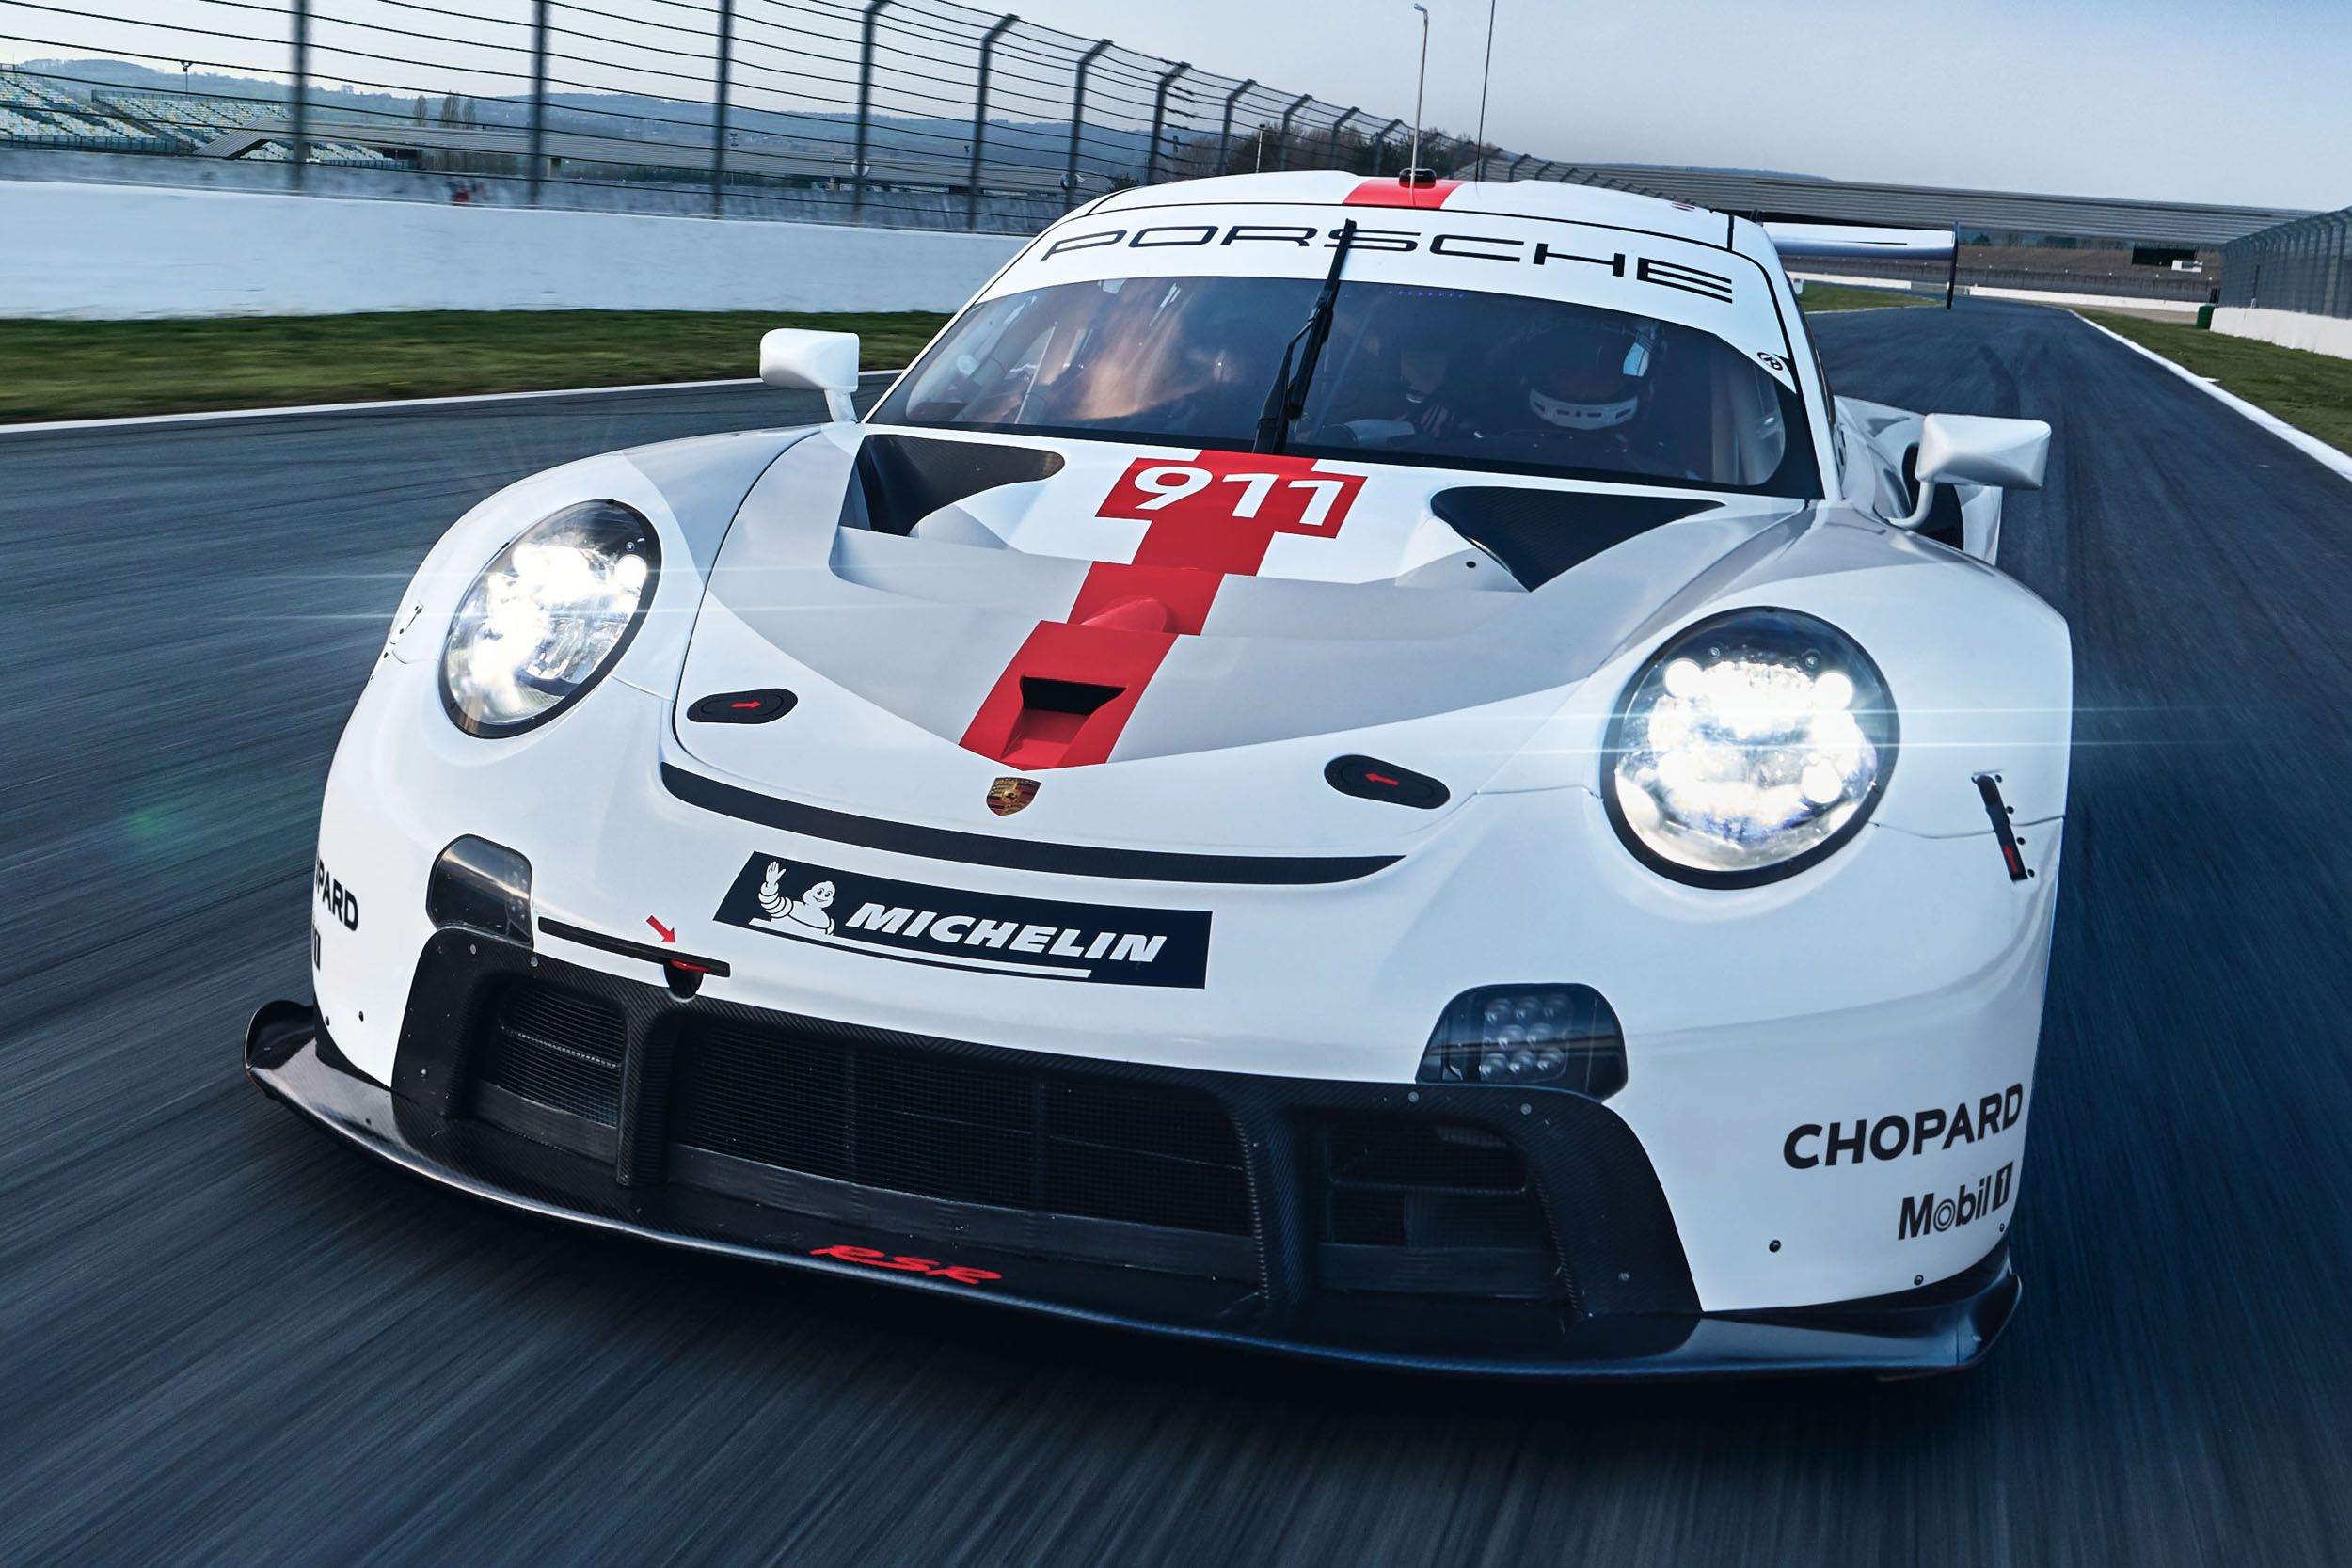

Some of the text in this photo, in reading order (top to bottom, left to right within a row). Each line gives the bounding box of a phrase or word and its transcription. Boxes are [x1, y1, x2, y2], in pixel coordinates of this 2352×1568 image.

[1041, 225, 1733, 304] PORSCHE
[1133, 466, 1346, 528] 911
[316, 856, 359, 932] PARD
[846, 902, 1168, 964] MICHELIN
[1783, 1083, 2023, 1170] CHOPARD
[1898, 1175, 1992, 1241] Mobil
